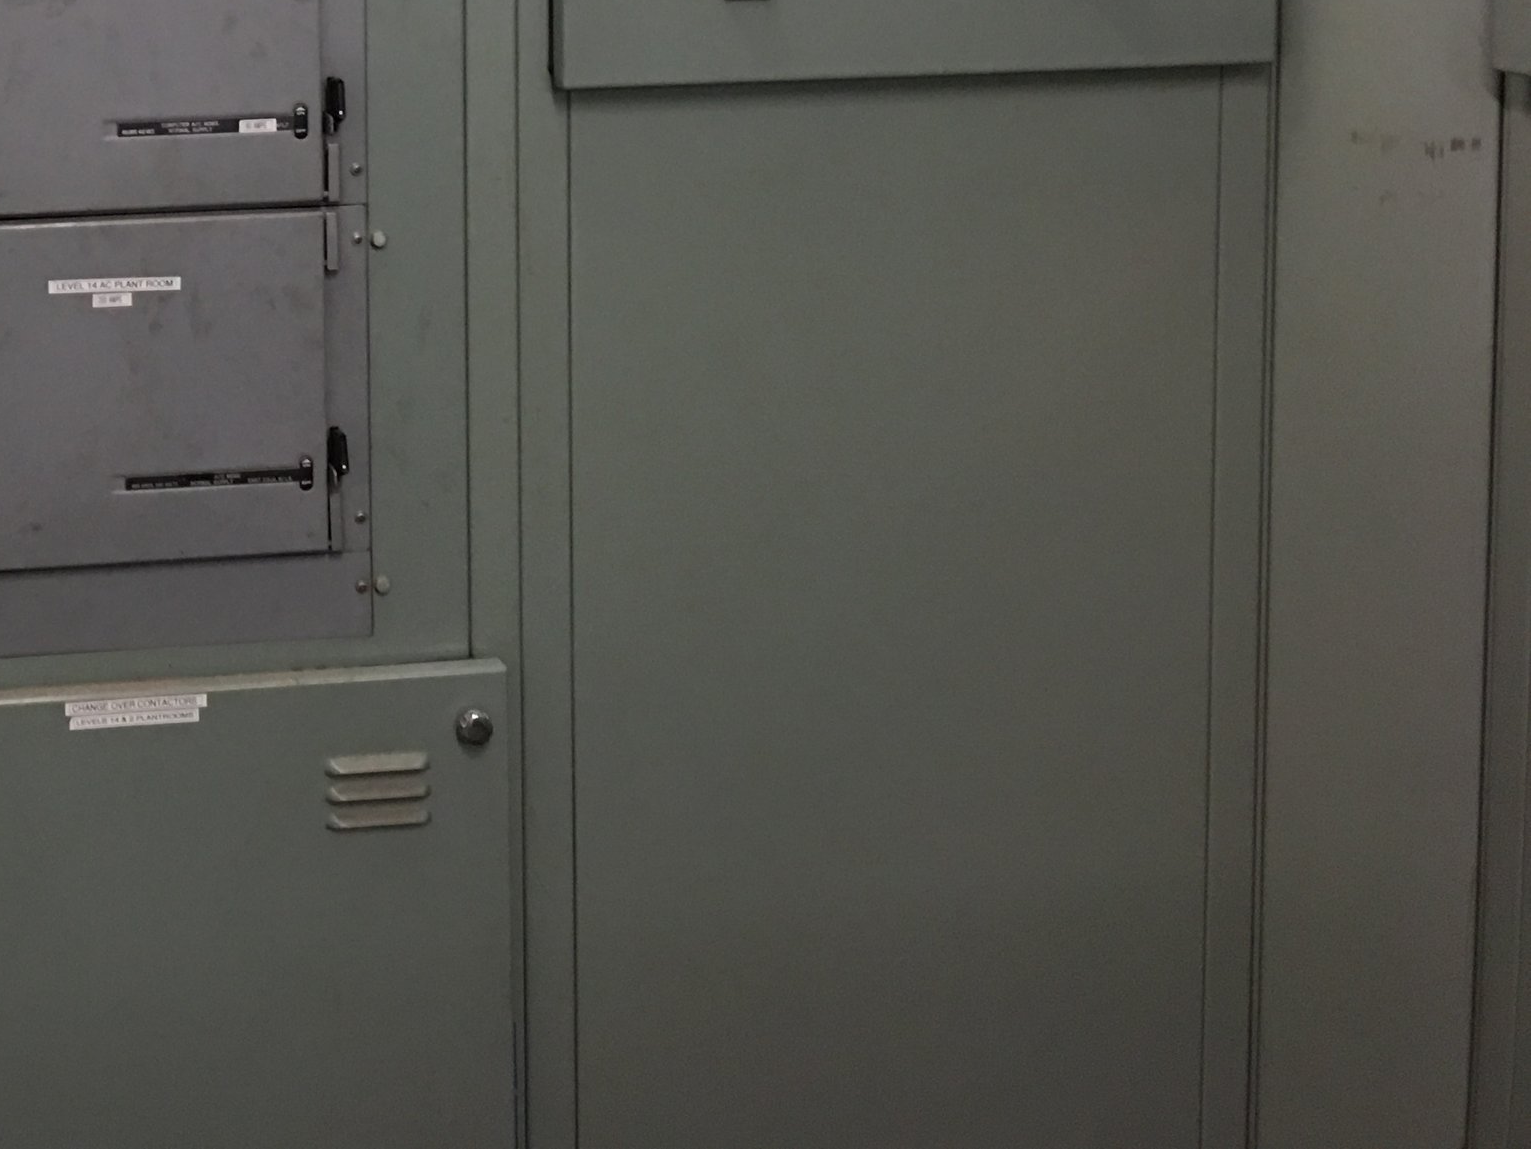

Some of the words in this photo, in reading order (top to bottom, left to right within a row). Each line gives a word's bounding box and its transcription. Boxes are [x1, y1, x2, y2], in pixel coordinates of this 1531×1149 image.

[56, 281, 84, 291] LEVEL
[87, 281, 97, 289] 14
[114, 279, 143, 289] PLANT
[146, 278, 174, 288] ROOM
[71, 701, 106, 713] CHANGE
[110, 699, 135, 709] OVER
[137, 696, 197, 709] CONTACTORS
